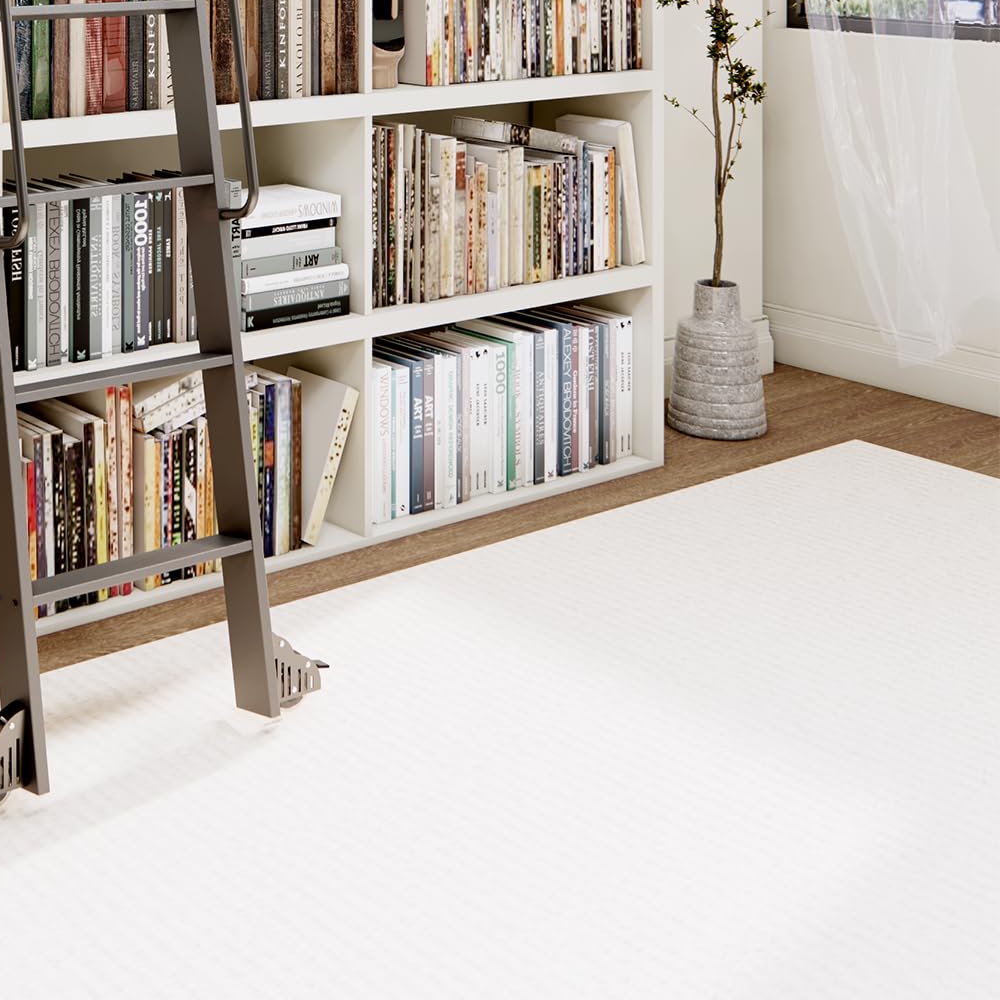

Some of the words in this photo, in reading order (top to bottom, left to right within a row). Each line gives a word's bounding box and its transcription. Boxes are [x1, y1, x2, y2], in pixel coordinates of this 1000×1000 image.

[298, 200, 338, 218] WINDOWS
[304, 254, 320, 267] ART
[273, 290, 325, 305] ANTIQUAIRES
[562, 328, 572, 378] ALEXEY
[495, 352, 506, 395] 1000
[380, 373, 390, 438] WINDOWS
[414, 397, 423, 422] ART
[425, 395, 434, 419] ART
[537, 370, 545, 446] ANTIQUAIRES
[562, 382, 572, 466] BRODOVITCH
